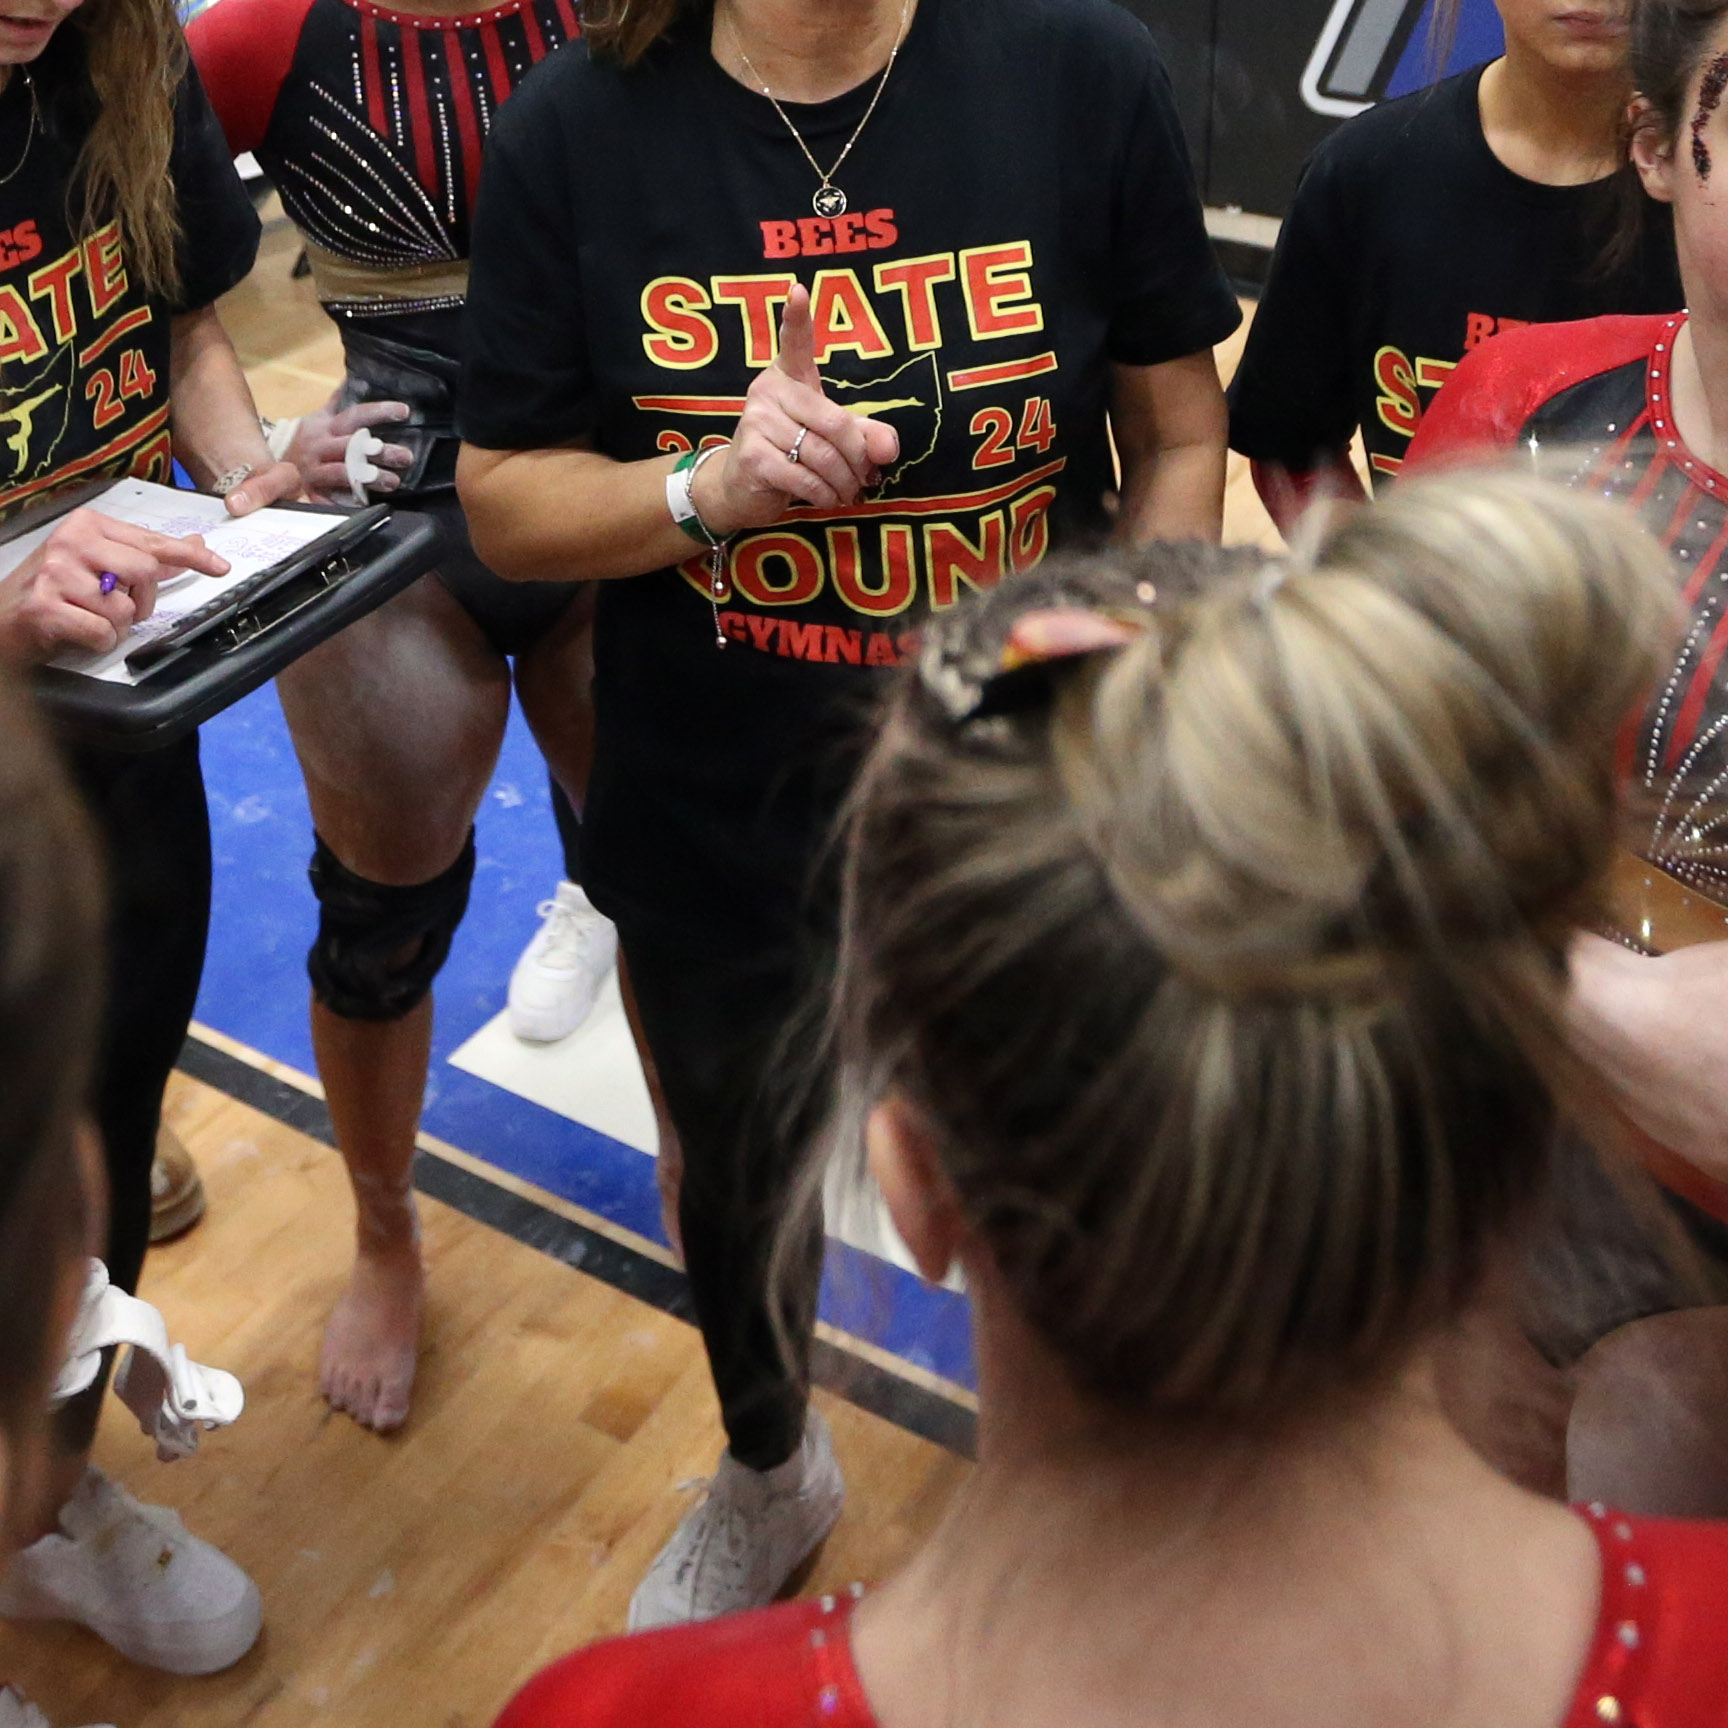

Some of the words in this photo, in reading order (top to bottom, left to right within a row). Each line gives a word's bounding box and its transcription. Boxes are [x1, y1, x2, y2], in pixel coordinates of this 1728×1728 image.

[759, 208, 899, 259] BEES
[640, 240, 1044, 370] STATE
[85, 349, 157, 430] 24
[969, 396, 1057, 471] 24
